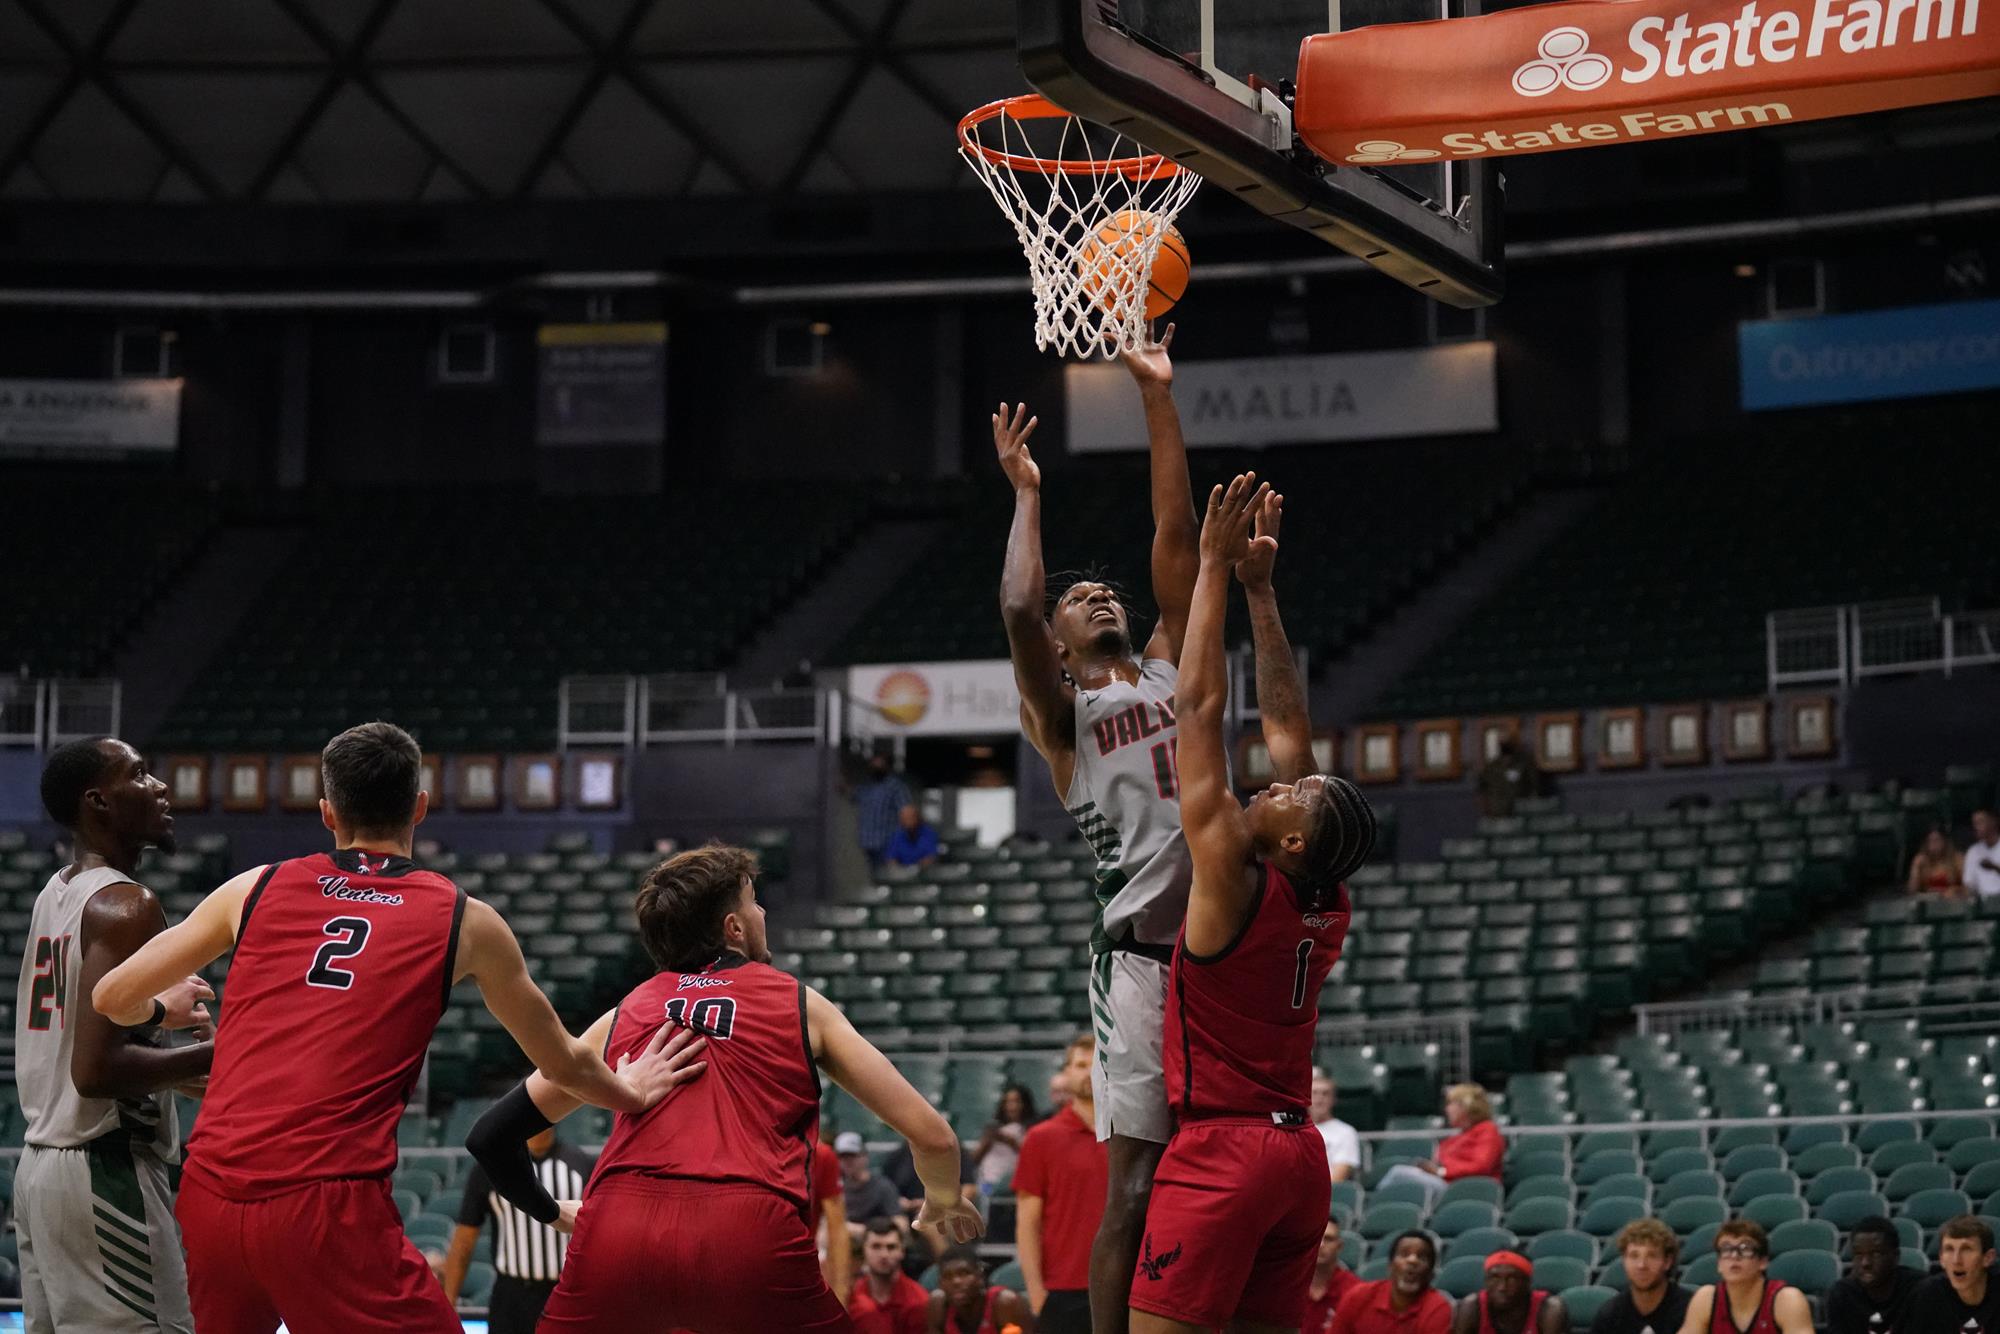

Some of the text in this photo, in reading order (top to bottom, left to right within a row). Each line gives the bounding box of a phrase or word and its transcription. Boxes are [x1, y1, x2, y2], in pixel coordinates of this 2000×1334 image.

[1193, 380, 1359, 423] MALIA
[1093, 695, 1177, 757] VALL
[1150, 736, 1180, 800] 1
[317, 875, 404, 906] Venters
[306, 915, 372, 991] 2
[1291, 938, 1315, 1009] 1
[664, 996, 737, 1041] 10
